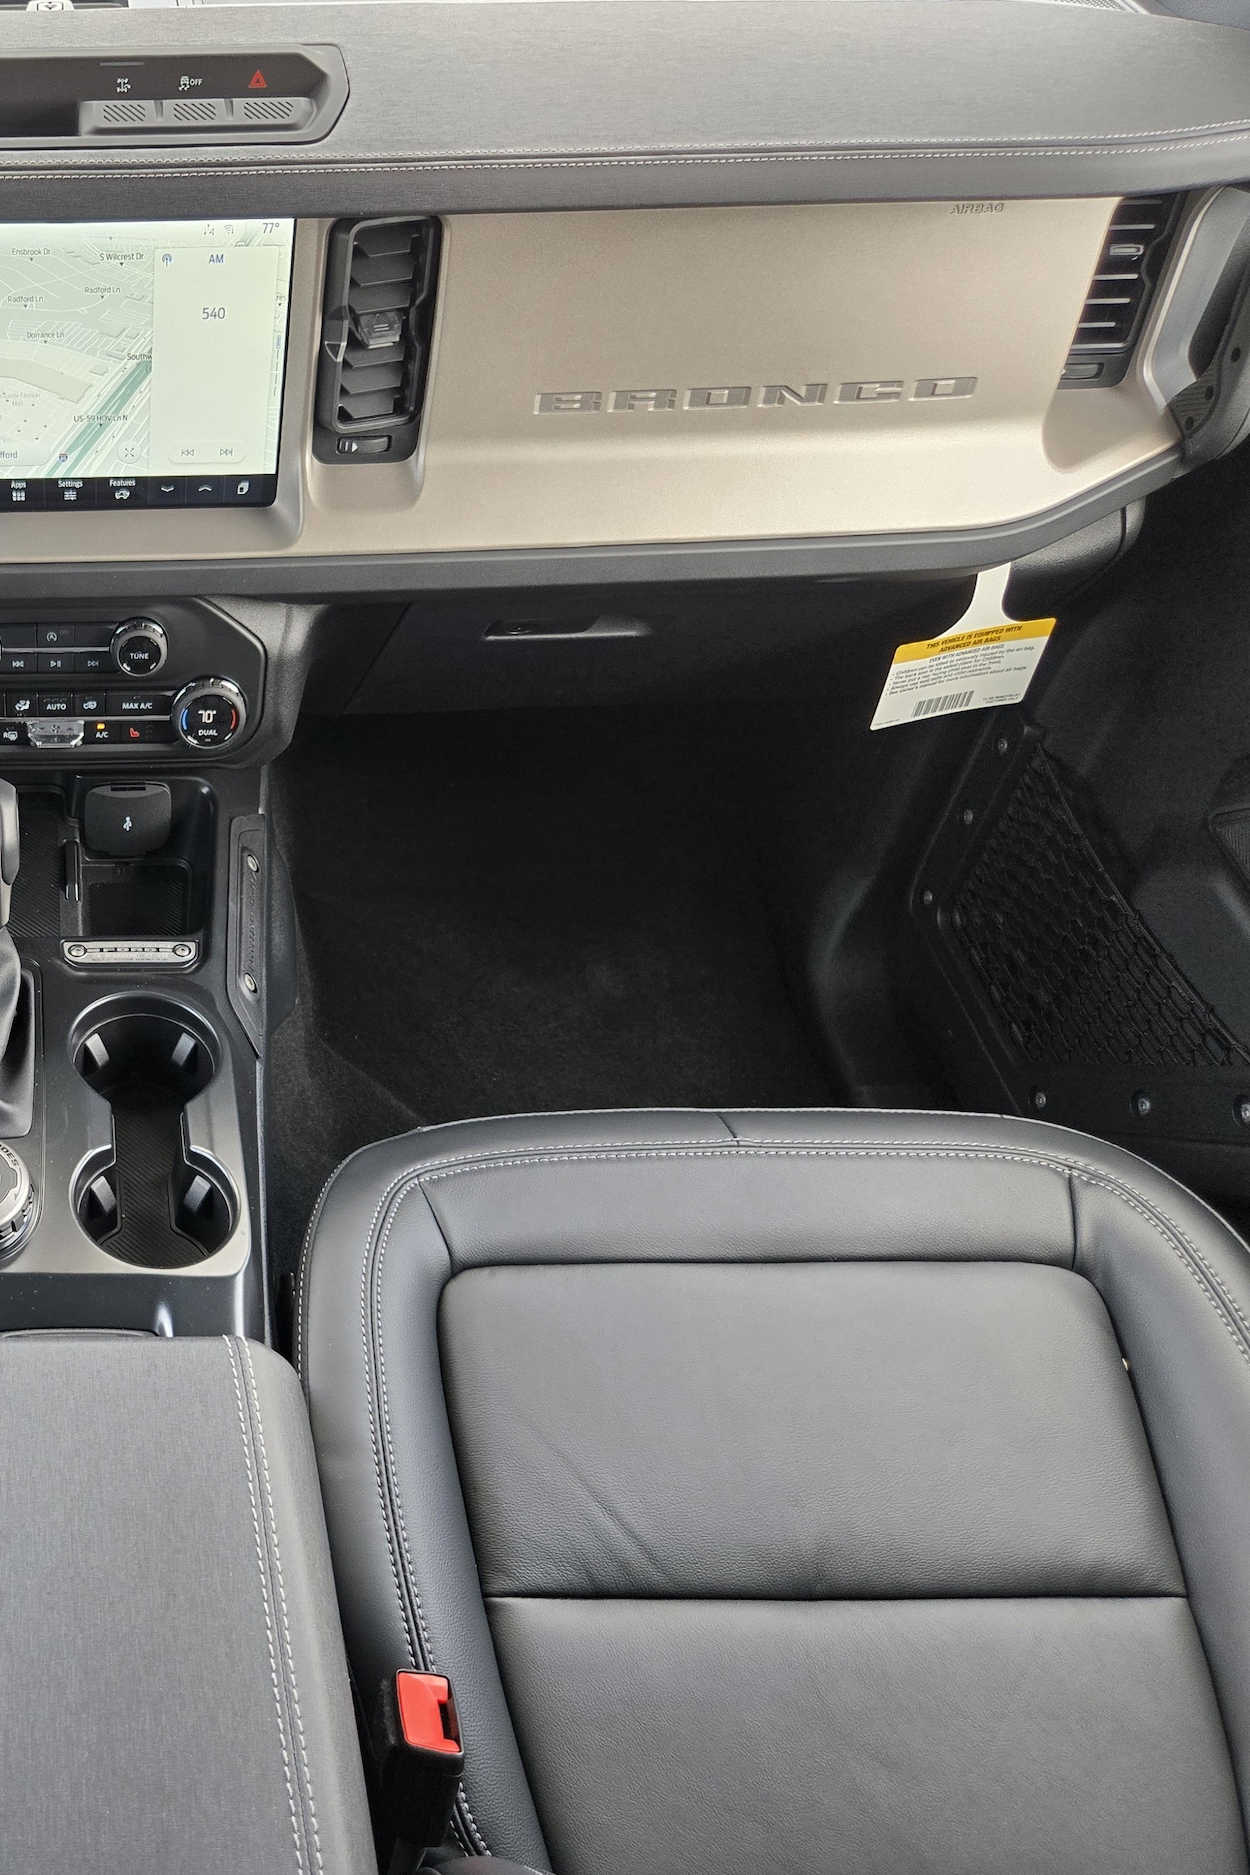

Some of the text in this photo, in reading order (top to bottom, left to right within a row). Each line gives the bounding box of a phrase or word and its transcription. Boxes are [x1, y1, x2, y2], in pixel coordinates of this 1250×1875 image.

[190, 78, 202, 86] OFF
[950, 202, 1004, 215] AIRBAG
[106, 253, 134, 261] Wilcrest
[209, 255, 224, 264] AM
[202, 307, 225, 320] 540
[533, 376, 977, 415] BRONCO
[11, 481, 26, 489] Apps
[58, 480, 83, 489] Settings
[110, 479, 135, 487] Features
[941, 636, 965, 645] VEHICLE
[973, 629, 1005, 639] EQUIPPED
[939, 641, 971, 652] ADVANCED
[984, 635, 1002, 643] BAGS
[46, 703, 66, 711] AUTO
